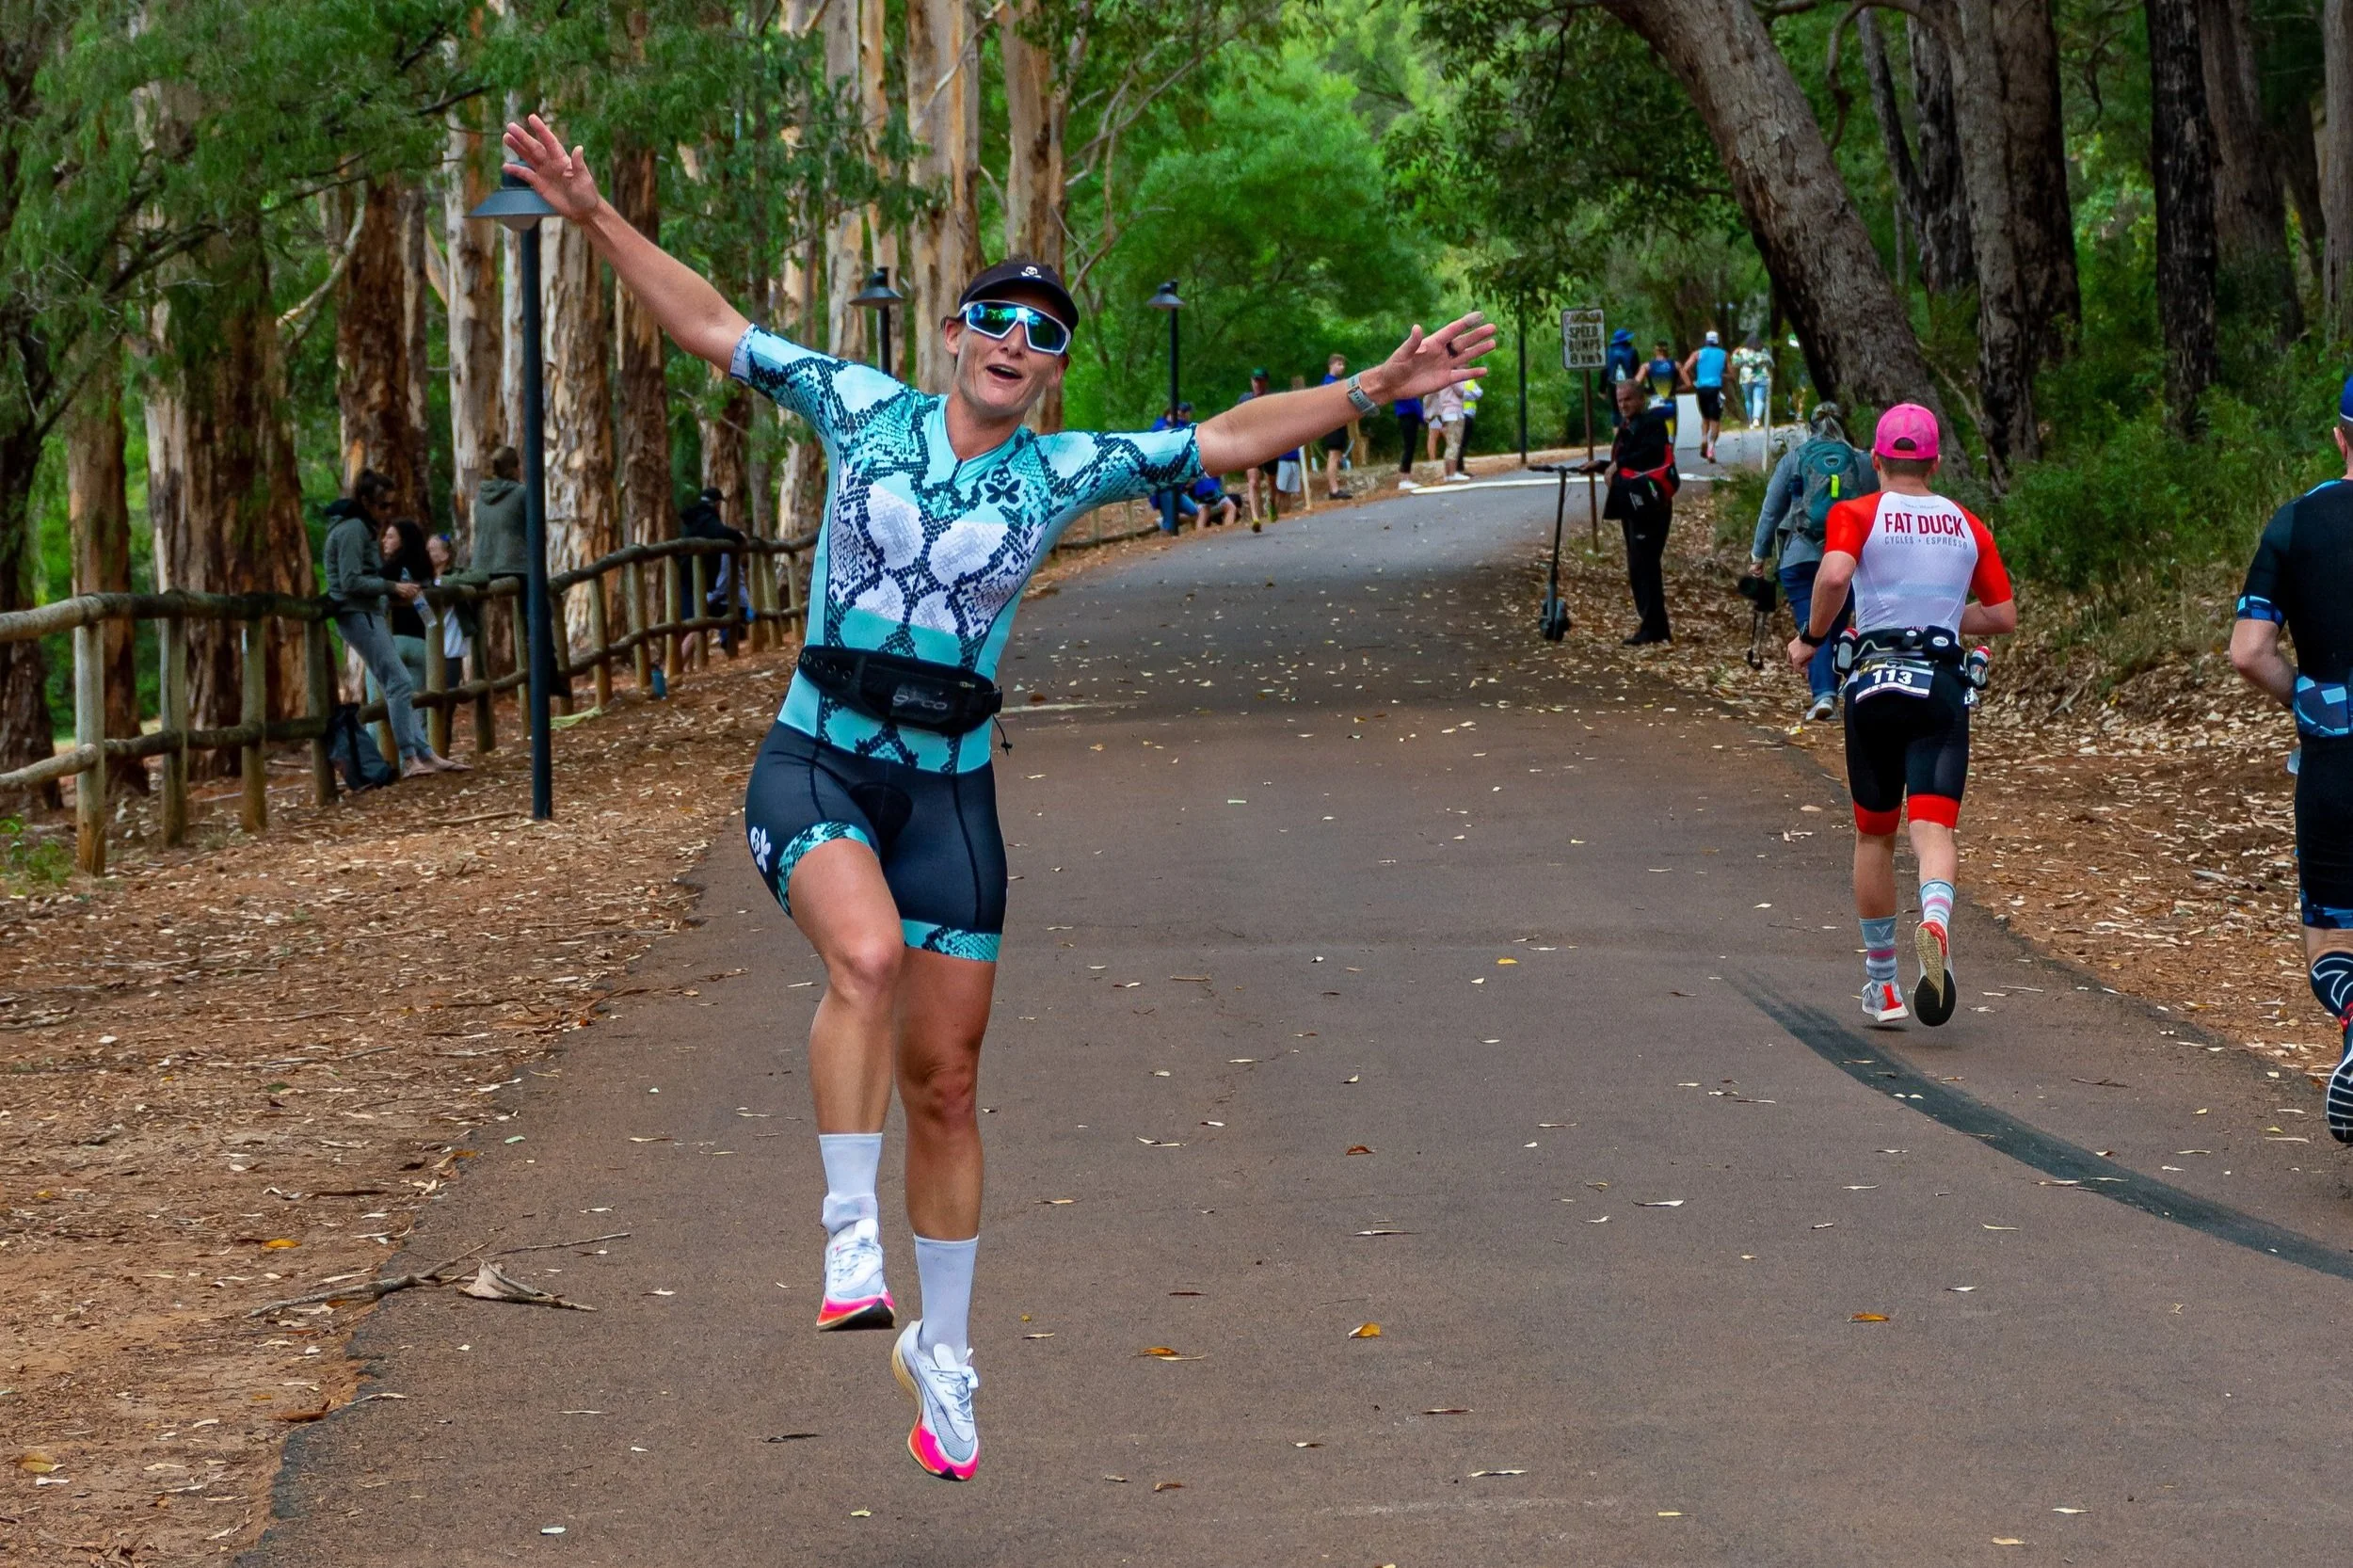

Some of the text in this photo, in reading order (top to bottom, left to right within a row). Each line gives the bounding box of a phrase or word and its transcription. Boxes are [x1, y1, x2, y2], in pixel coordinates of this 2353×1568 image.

[1568, 327, 1598, 338] SPEED
[1884, 513, 1965, 538] FAT DUCK
[1884, 536, 1968, 550] CYCLES ESPRESSO
[1872, 669, 1913, 685] 113
